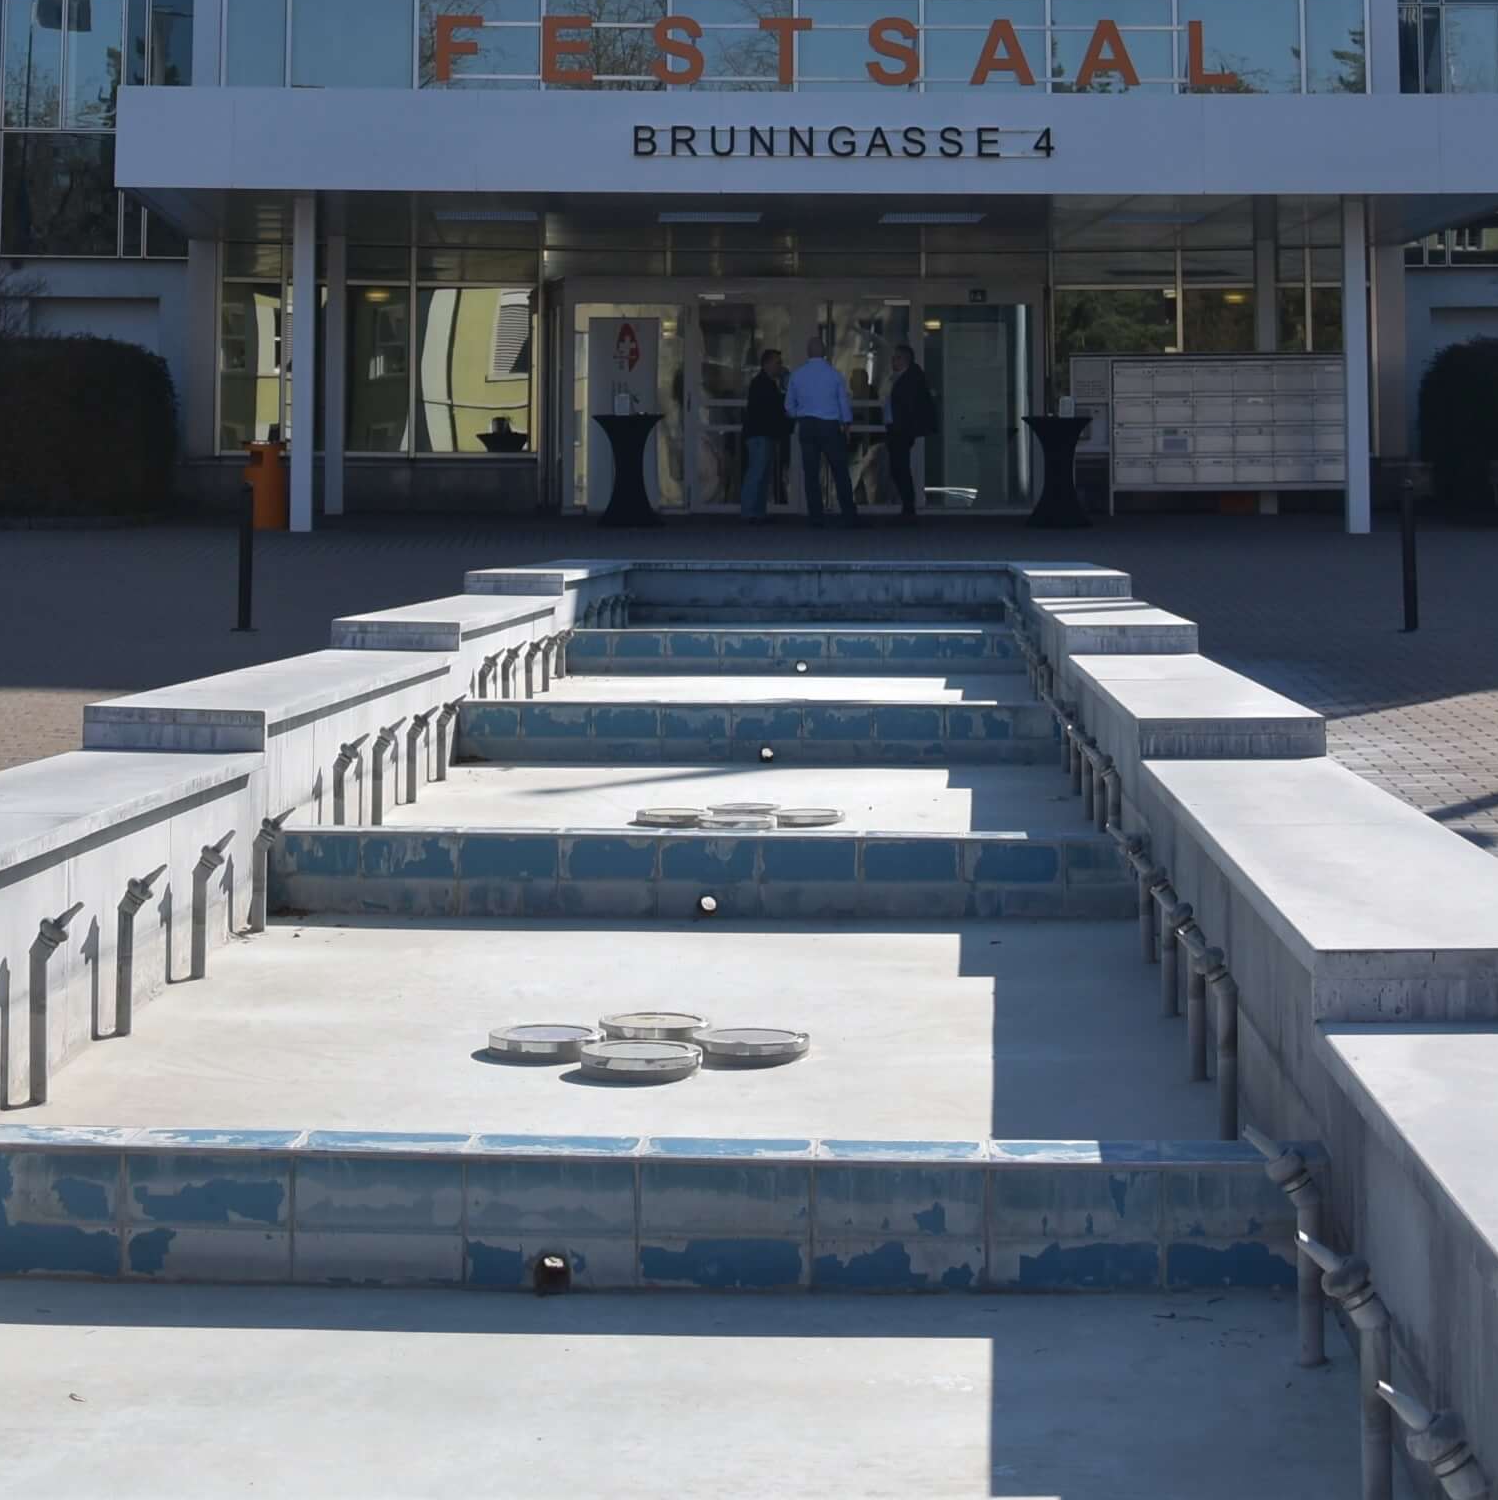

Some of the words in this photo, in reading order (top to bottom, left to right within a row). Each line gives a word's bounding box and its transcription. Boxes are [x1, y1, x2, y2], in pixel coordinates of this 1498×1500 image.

[434, 15, 1238, 87] FESTSAAL
[633, 125, 1000, 157] BRUNNGASSE
[1032, 127, 1057, 158] 4
